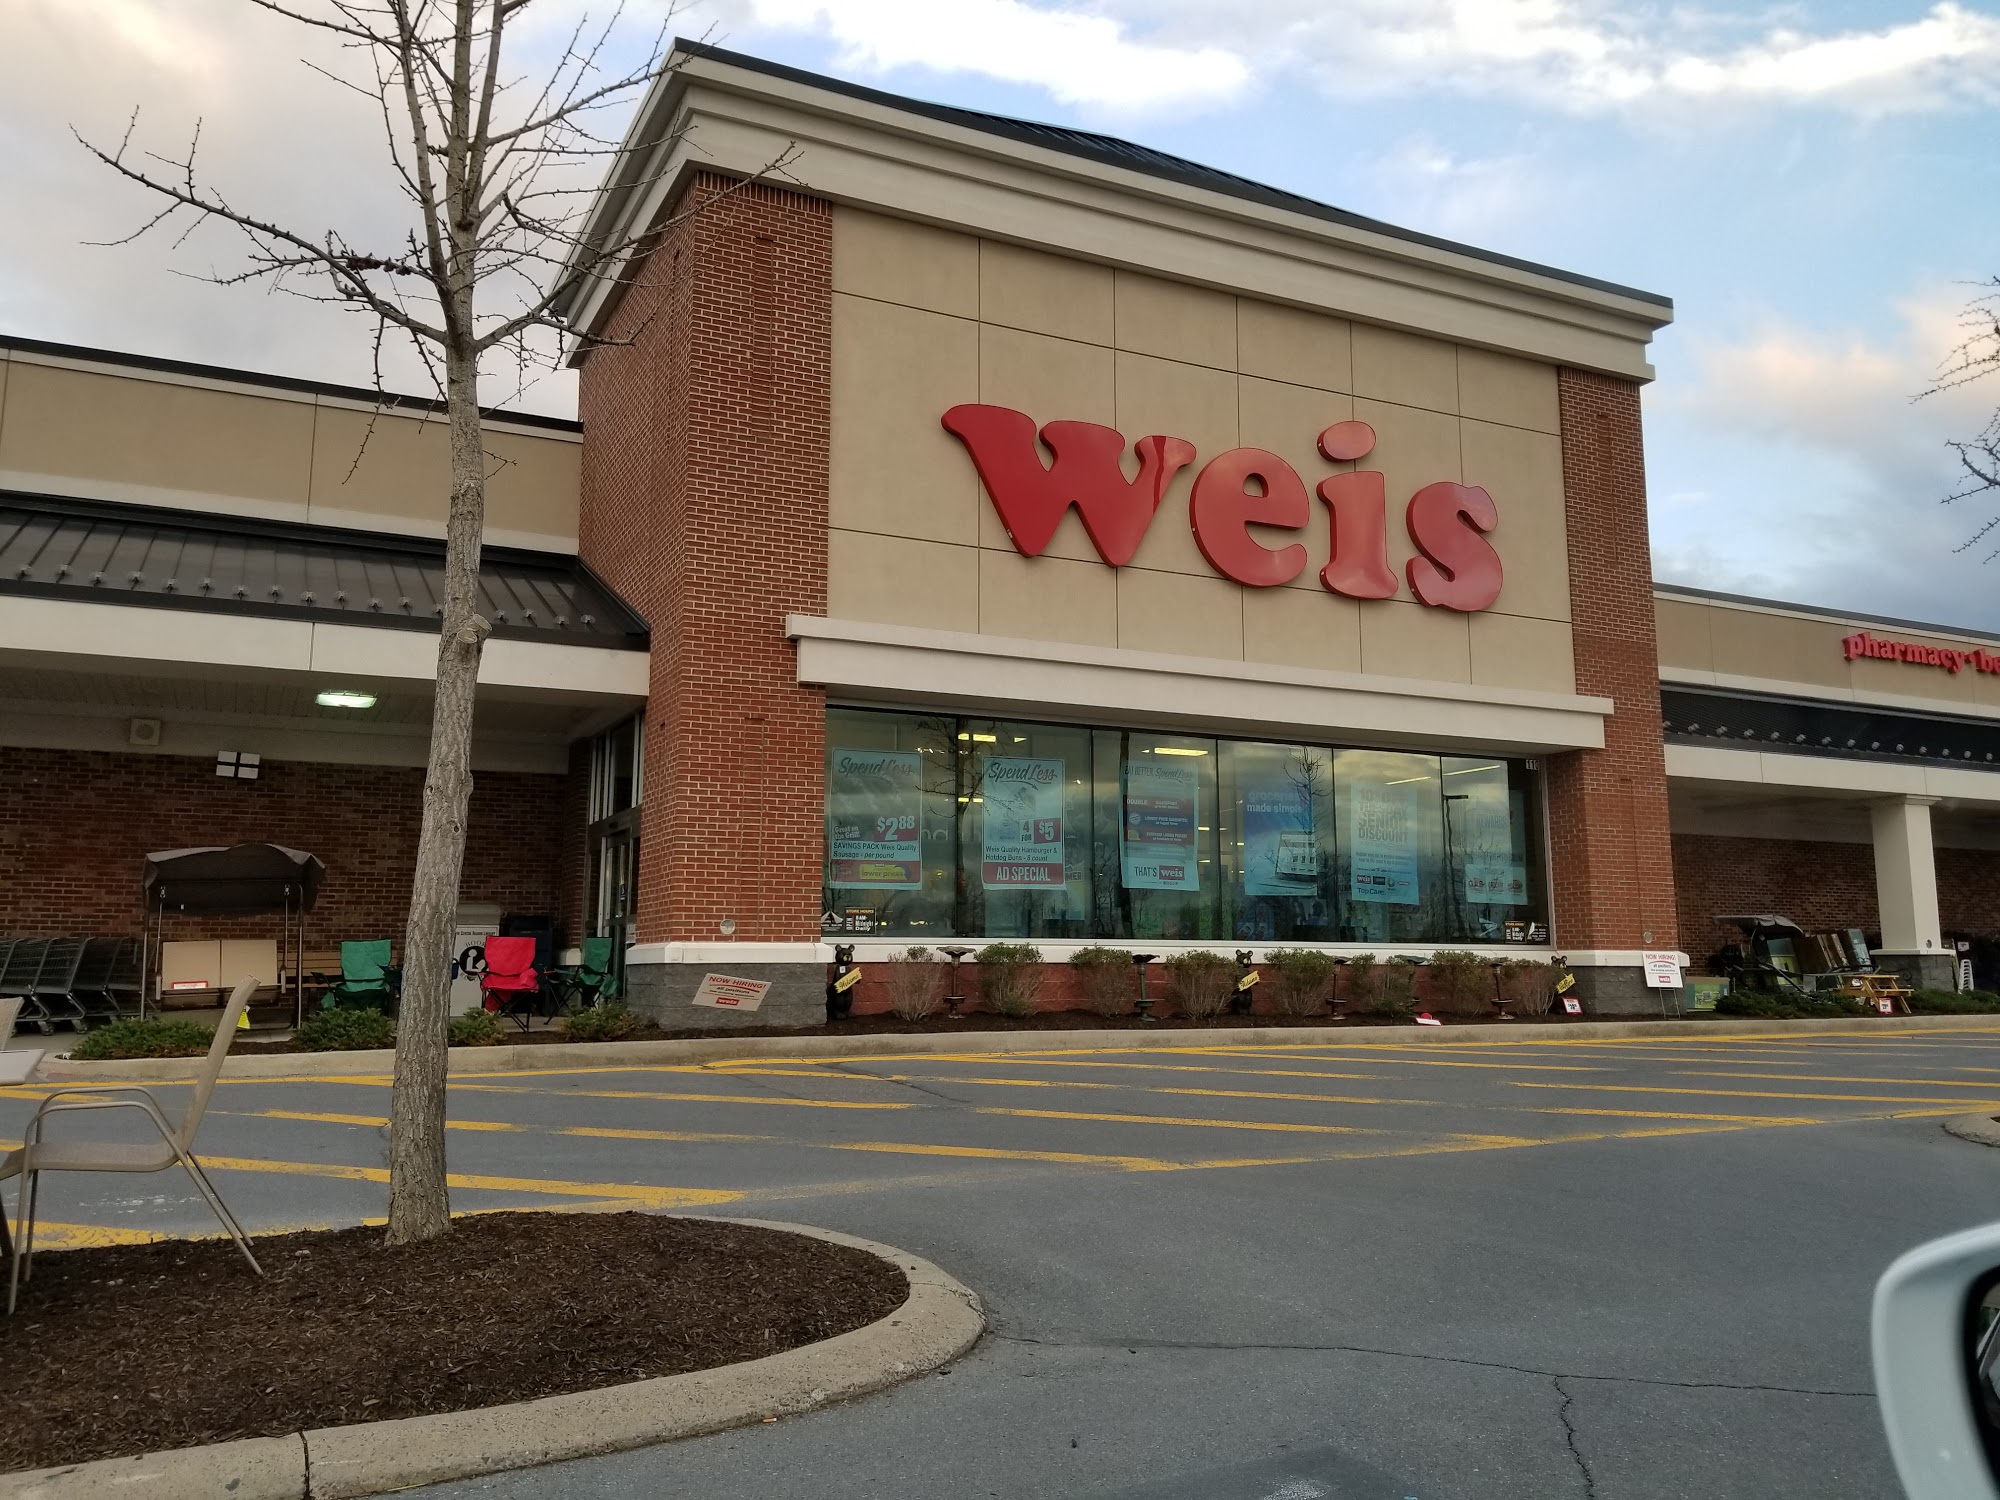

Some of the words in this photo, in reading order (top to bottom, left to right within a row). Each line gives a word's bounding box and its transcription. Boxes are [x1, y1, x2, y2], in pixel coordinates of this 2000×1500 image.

[941, 404, 1504, 613] weis
[1842, 631, 1965, 673] pharmacy
[839, 757, 885, 777] Spend
[881, 759, 915, 776] Less
[989, 762, 1030, 782] Spend
[1028, 765, 1058, 781] Less
[1155, 768, 1178, 779] Spend
[1247, 803, 1271, 812] made
[1273, 804, 1302, 814] simple
[1022, 820, 1030, 832] 4
[1038, 821, 1055, 841] $5
[1358, 827, 1408, 842] DISCOUNT
[833, 842, 861, 850] SAVINGS
[862, 842, 880, 850] PACK
[881, 843, 896, 851] Weis
[897, 843, 916, 852] Quality
[1000, 846, 1020, 854] Quality
[1021, 846, 1052, 854] Hamburger
[833, 851, 859, 859] Sausage
[882, 870, 904, 878] prices
[996, 866, 1010, 880] AD
[1011, 866, 1051, 881] SPECIAL
[1134, 866, 1157, 877] THAT'S
[1160, 868, 1183, 877] weis
[709, 976, 730, 984] NOW
[732, 980, 766, 989] HIRING!
